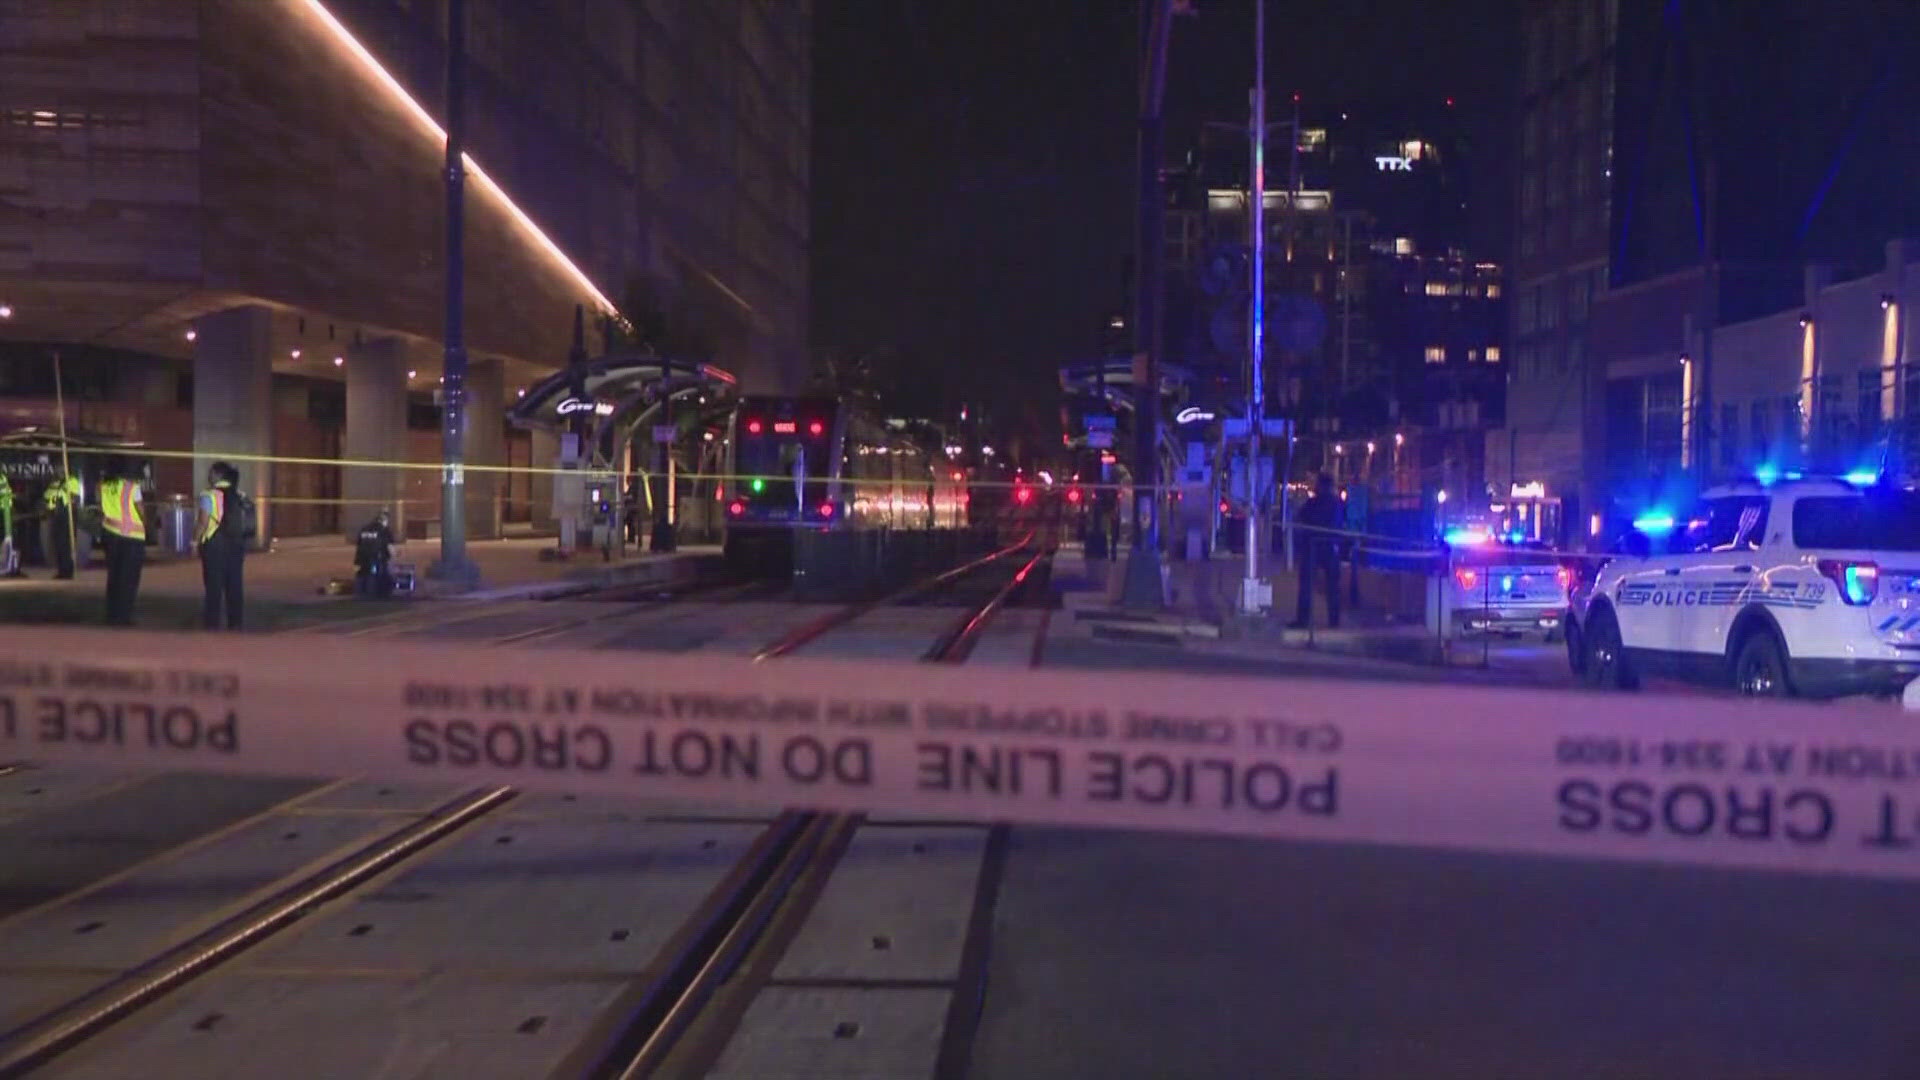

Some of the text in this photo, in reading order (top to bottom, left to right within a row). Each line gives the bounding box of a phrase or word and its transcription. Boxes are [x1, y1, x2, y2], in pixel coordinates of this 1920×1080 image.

[1375, 157, 1412, 171] TTX
[1641, 590, 1711, 606] POLICE
[543, 686, 580, 714] AT
[591, 688, 820, 723] INFORMATION
[34, 696, 240, 754] POLICE
[1252, 719, 1343, 754] CALL
[405, 718, 1339, 817] POLICE LINE DO NOT CROSS
[1556, 778, 1835, 845] CROSS
